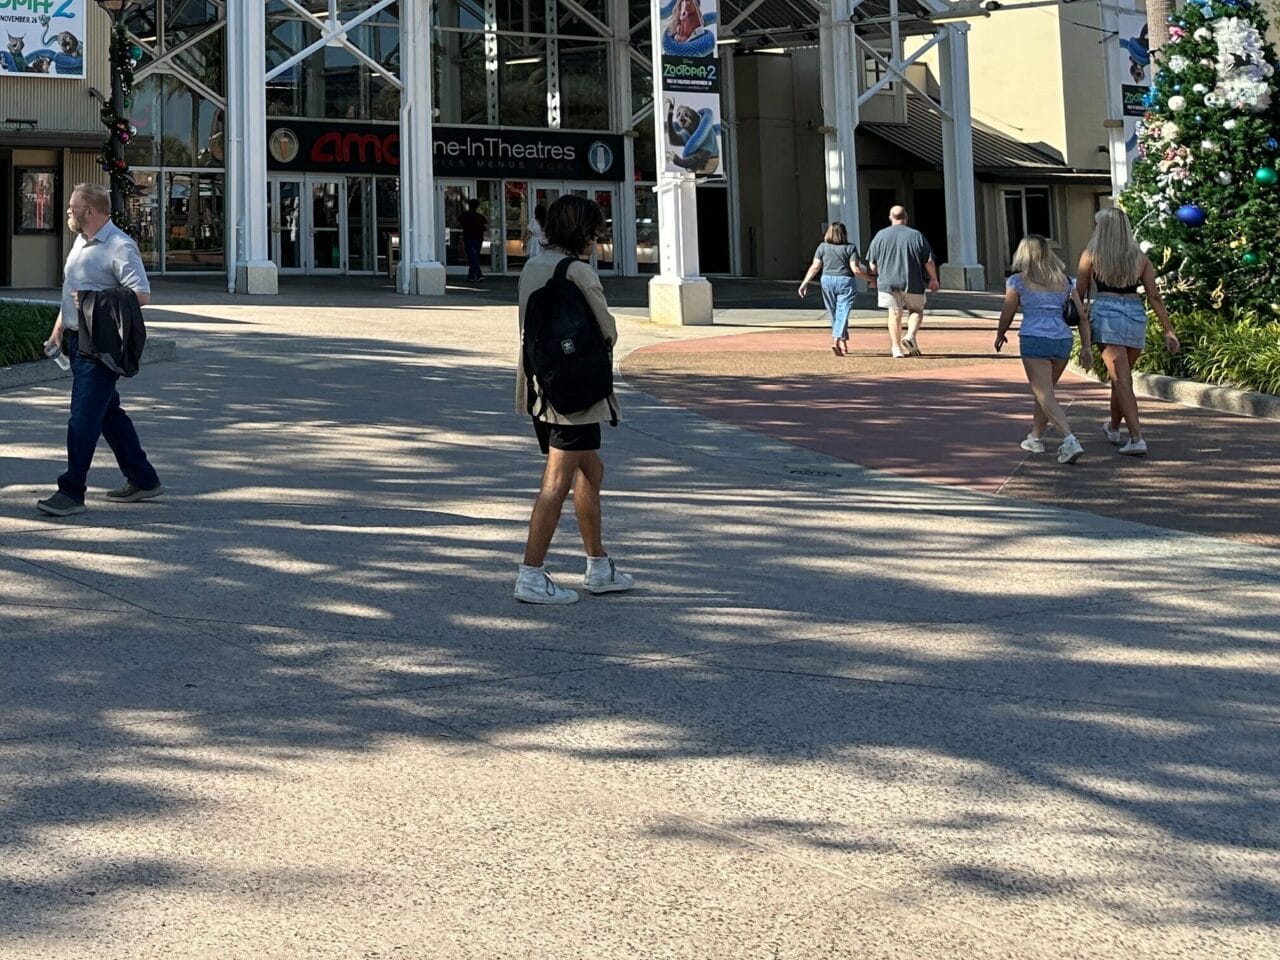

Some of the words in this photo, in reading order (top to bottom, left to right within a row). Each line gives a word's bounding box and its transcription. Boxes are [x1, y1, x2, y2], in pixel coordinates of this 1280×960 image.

[0, 15, 31, 23] NOVEMBER
[663, 63, 707, 78] ZOOTOPIA
[707, 65, 717, 80] 2
